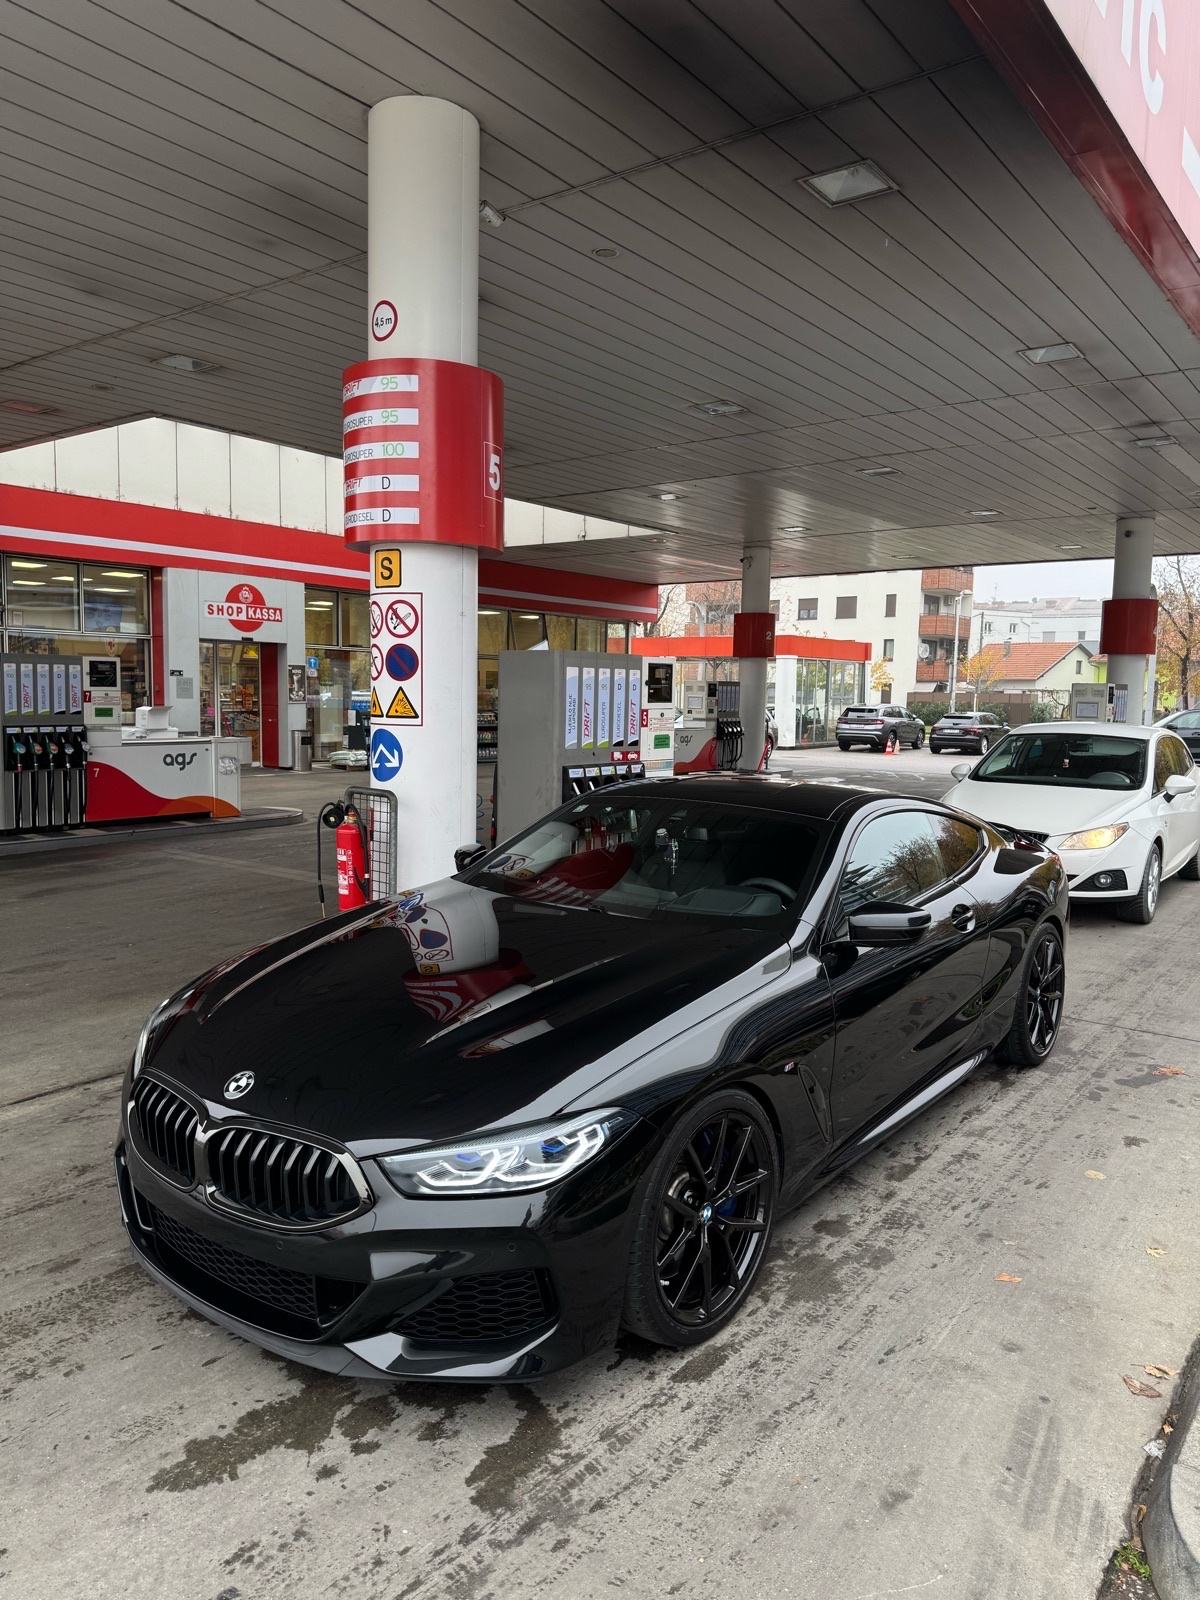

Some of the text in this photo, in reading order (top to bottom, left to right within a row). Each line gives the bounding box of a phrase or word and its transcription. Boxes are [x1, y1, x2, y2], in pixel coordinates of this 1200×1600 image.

[374, 316, 393, 327] 4,5 m
[380, 376, 398, 390] 95
[380, 409, 398, 424] 95
[382, 442, 404, 457] 100
[488, 454, 501, 491] 5
[381, 476, 391, 490] D
[382, 509, 391, 522] D
[380, 556, 393, 580] S
[207, 603, 281, 621] SHOP KASSA
[766, 631, 772, 640] 2
[617, 683, 622, 691] D
[632, 683, 637, 691] D
[85, 692, 90, 702] 7
[629, 699, 637, 737] DRIFT
[642, 711, 647, 726] 5
[680, 735, 692, 746] ags
[163, 752, 197, 772] ags
[93, 767, 100, 777] 7
